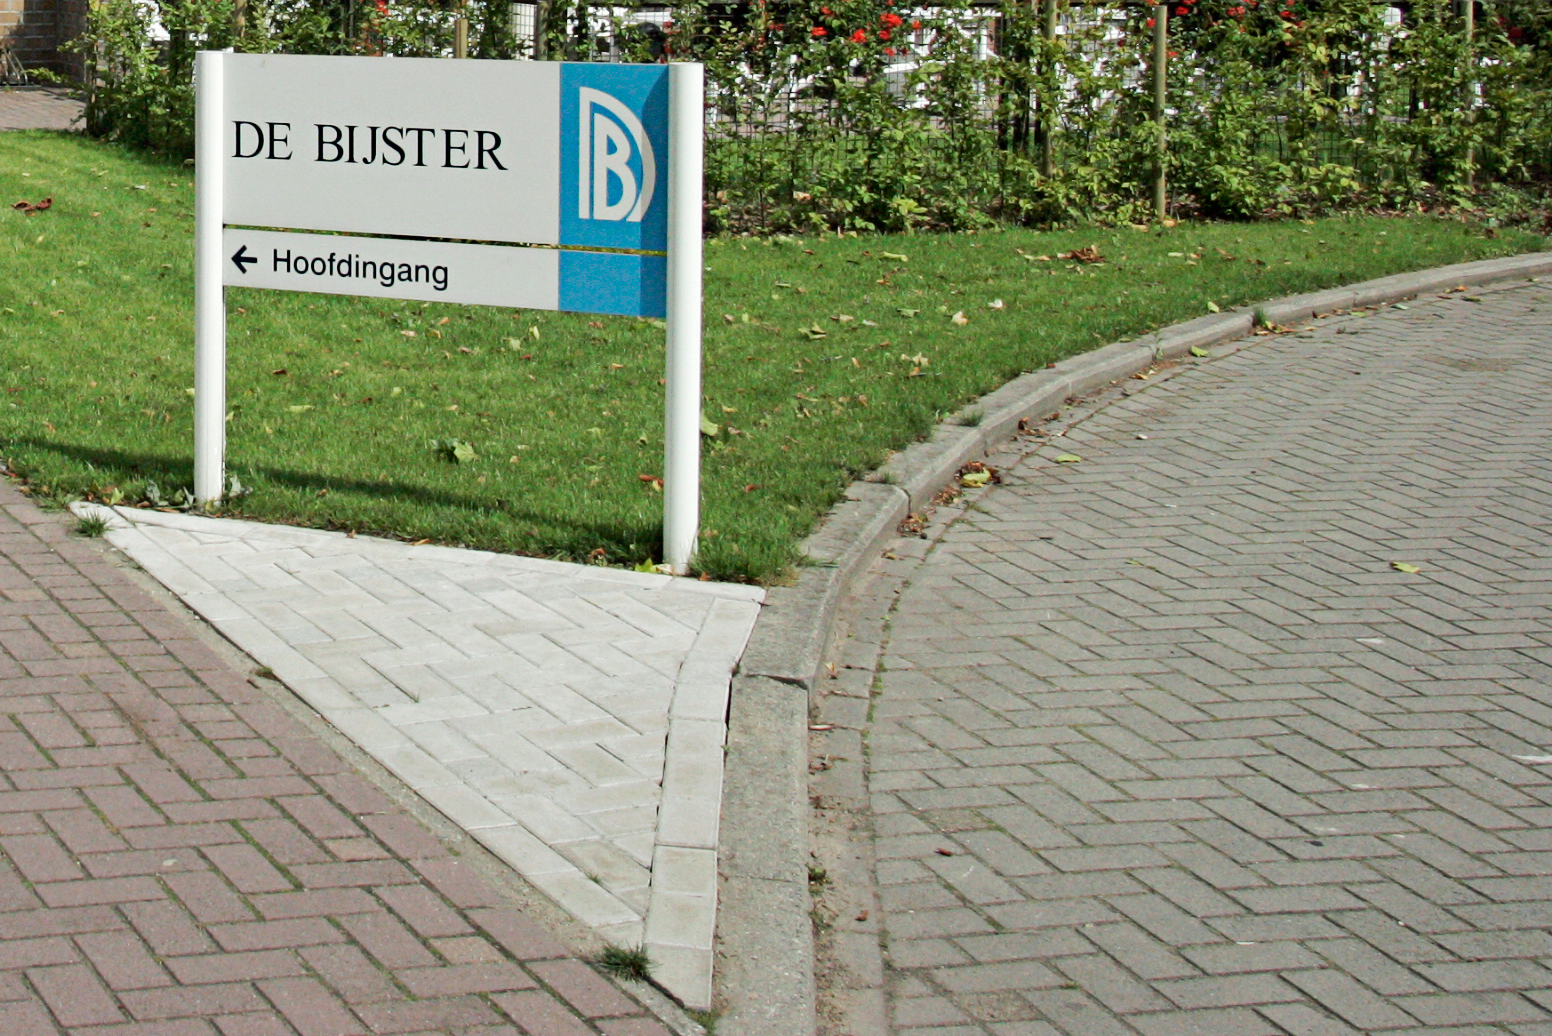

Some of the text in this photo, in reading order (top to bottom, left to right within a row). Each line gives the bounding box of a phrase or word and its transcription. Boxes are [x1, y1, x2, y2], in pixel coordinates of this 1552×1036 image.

[231, 120, 509, 171] DE BIJSTER
[273, 248, 449, 292] Hoofdingang
